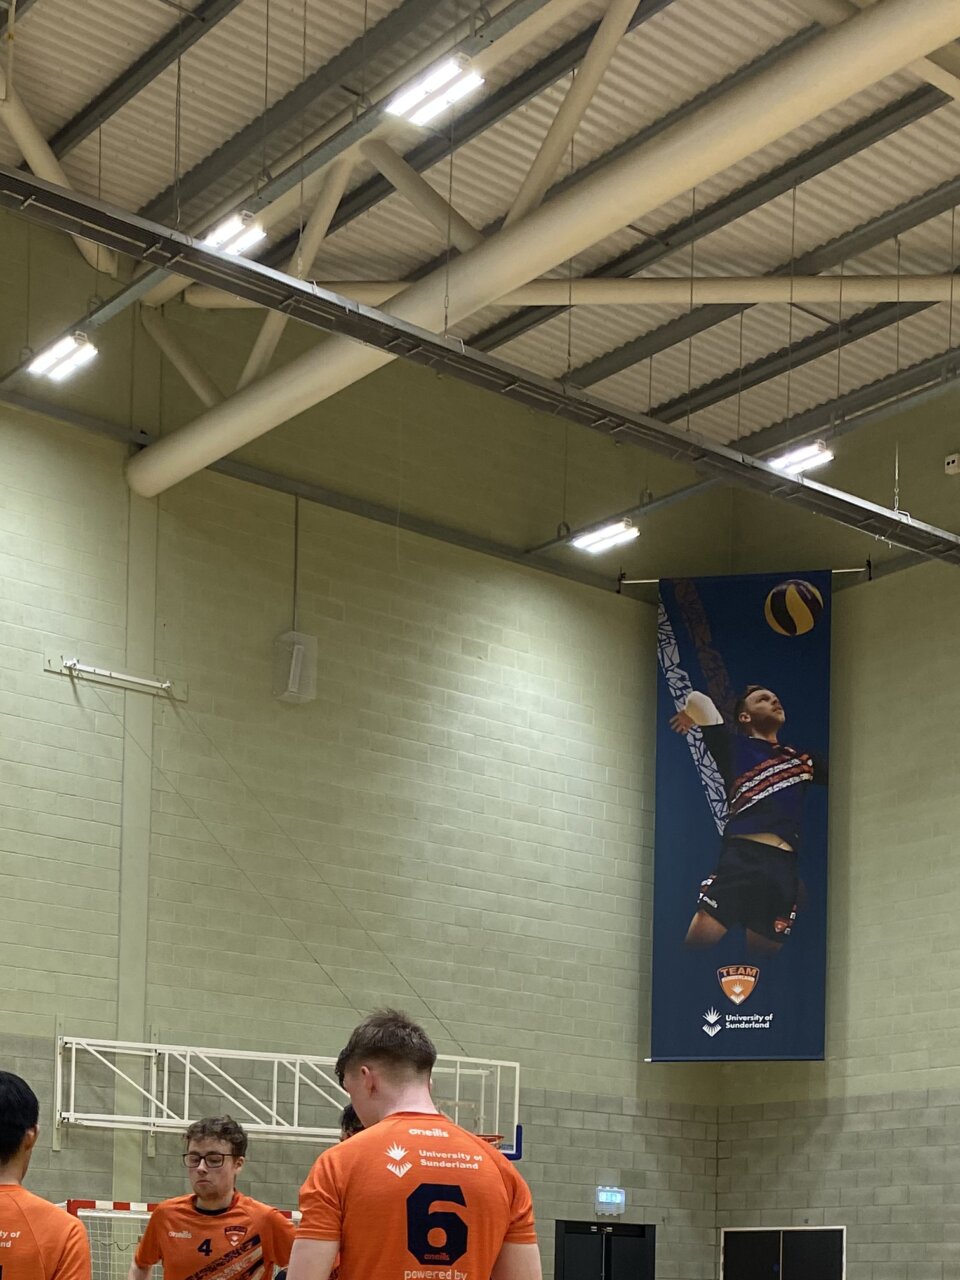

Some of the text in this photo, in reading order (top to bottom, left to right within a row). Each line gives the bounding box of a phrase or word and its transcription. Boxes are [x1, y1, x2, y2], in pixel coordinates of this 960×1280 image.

[721, 967, 757, 976] TEAM
[725, 1013, 774, 1023] University of
[725, 1021, 770, 1029] Sunderland
[419, 1149, 471, 1161] University
[420, 1158, 479, 1169] Sunderland
[406, 1183, 468, 1266] 6
[10, 1231, 21, 1239] of
[197, 1238, 213, 1257] 4
[403, 1269, 452, 1280] powered
